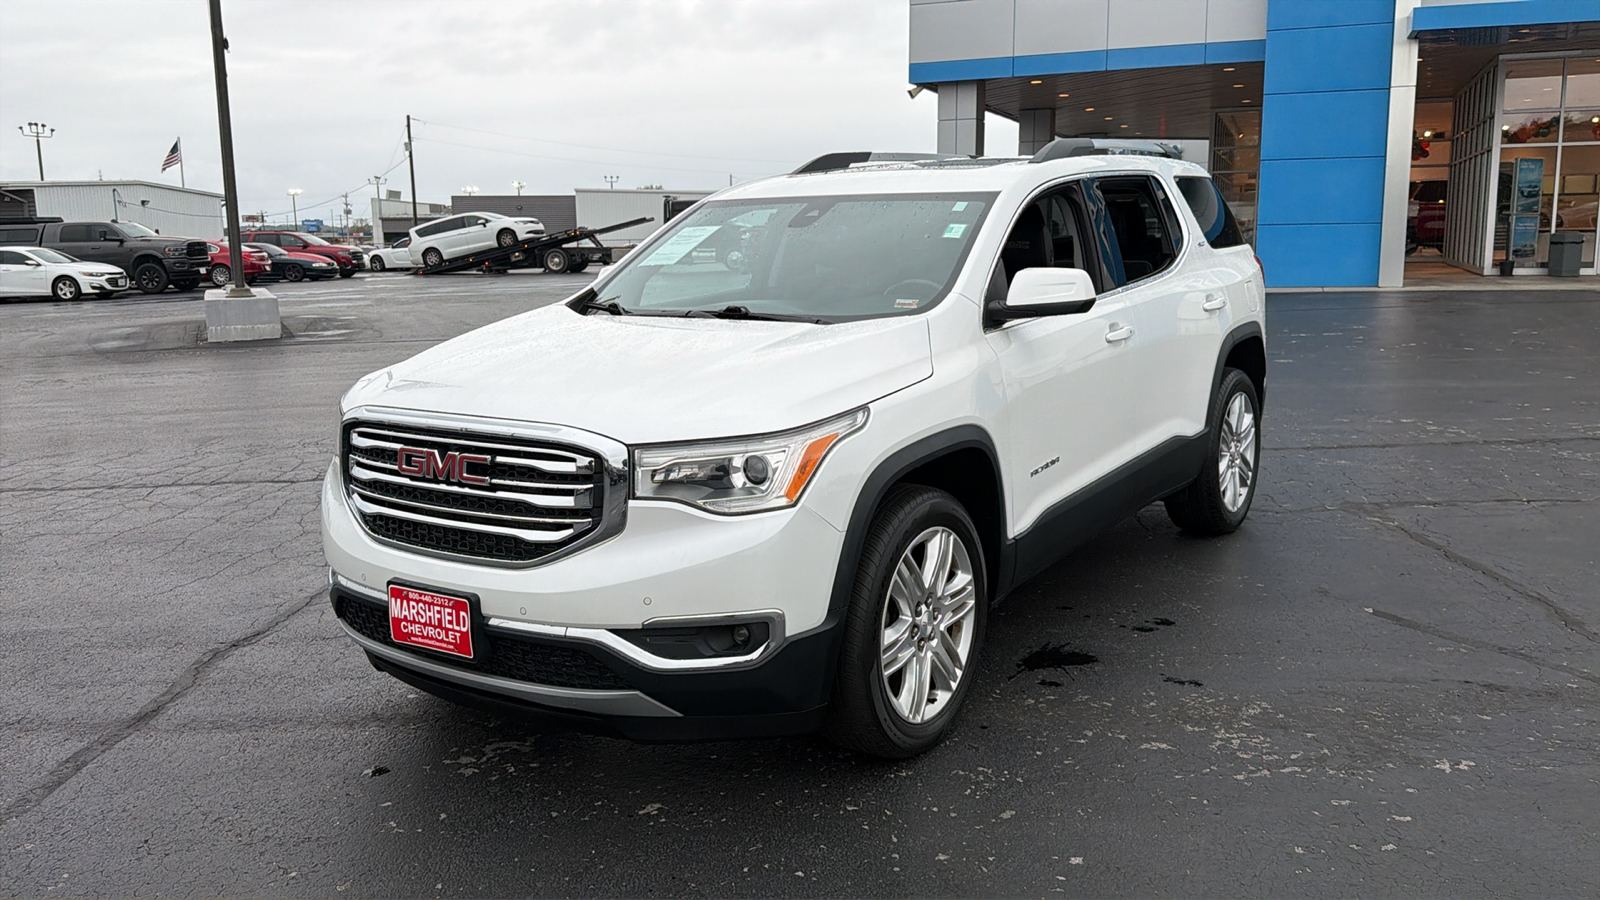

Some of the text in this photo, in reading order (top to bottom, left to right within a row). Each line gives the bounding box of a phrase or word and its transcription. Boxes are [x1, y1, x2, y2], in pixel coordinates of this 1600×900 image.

[397, 446, 491, 485] GMC
[408, 591, 449, 606] 800-440-2312
[391, 597, 468, 632] MARSHFIELD
[400, 621, 461, 644] CHEVROLET
